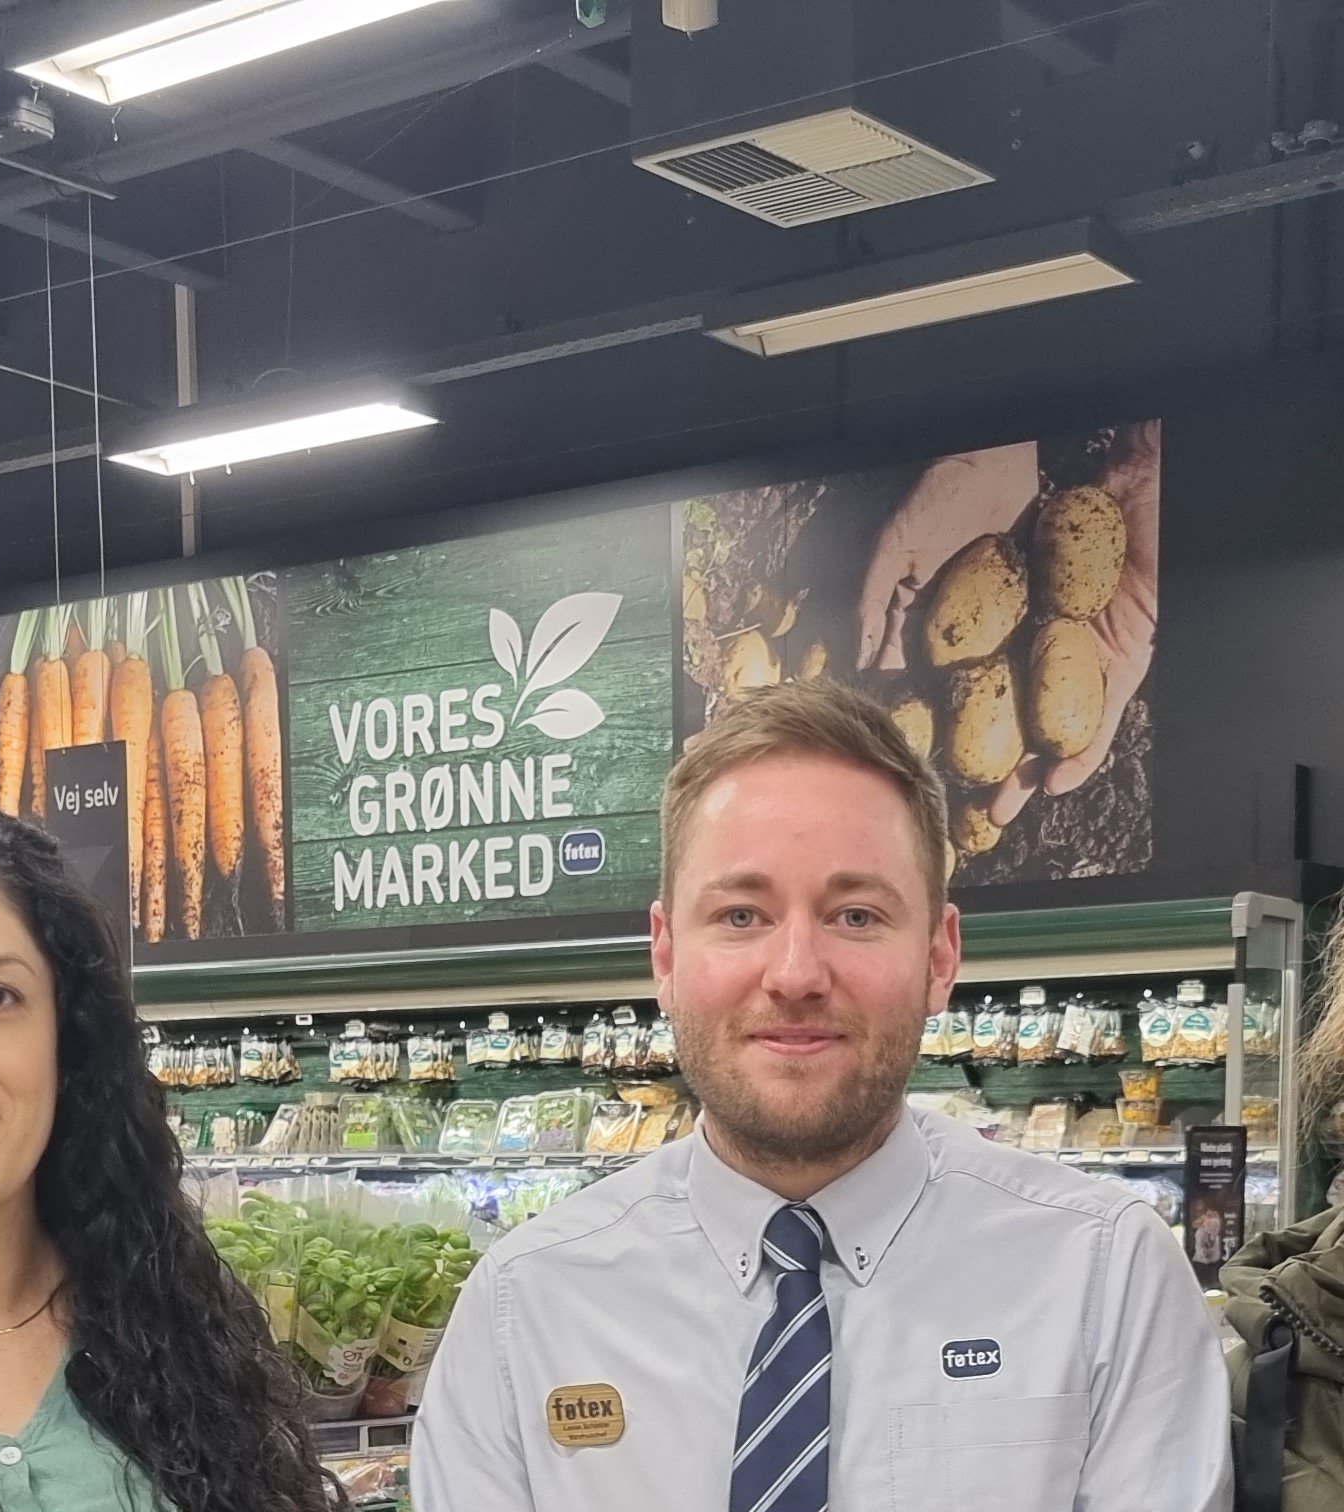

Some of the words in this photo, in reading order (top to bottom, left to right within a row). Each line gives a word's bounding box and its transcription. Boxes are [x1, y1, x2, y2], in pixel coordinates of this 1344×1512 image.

[328, 683, 505, 765] VORES
[53, 783, 80, 815] Vej
[84, 780, 119, 808] selv
[348, 752, 574, 837] GRØNNE
[332, 833, 554, 912] MARKED
[943, 1348, 999, 1368] føtex
